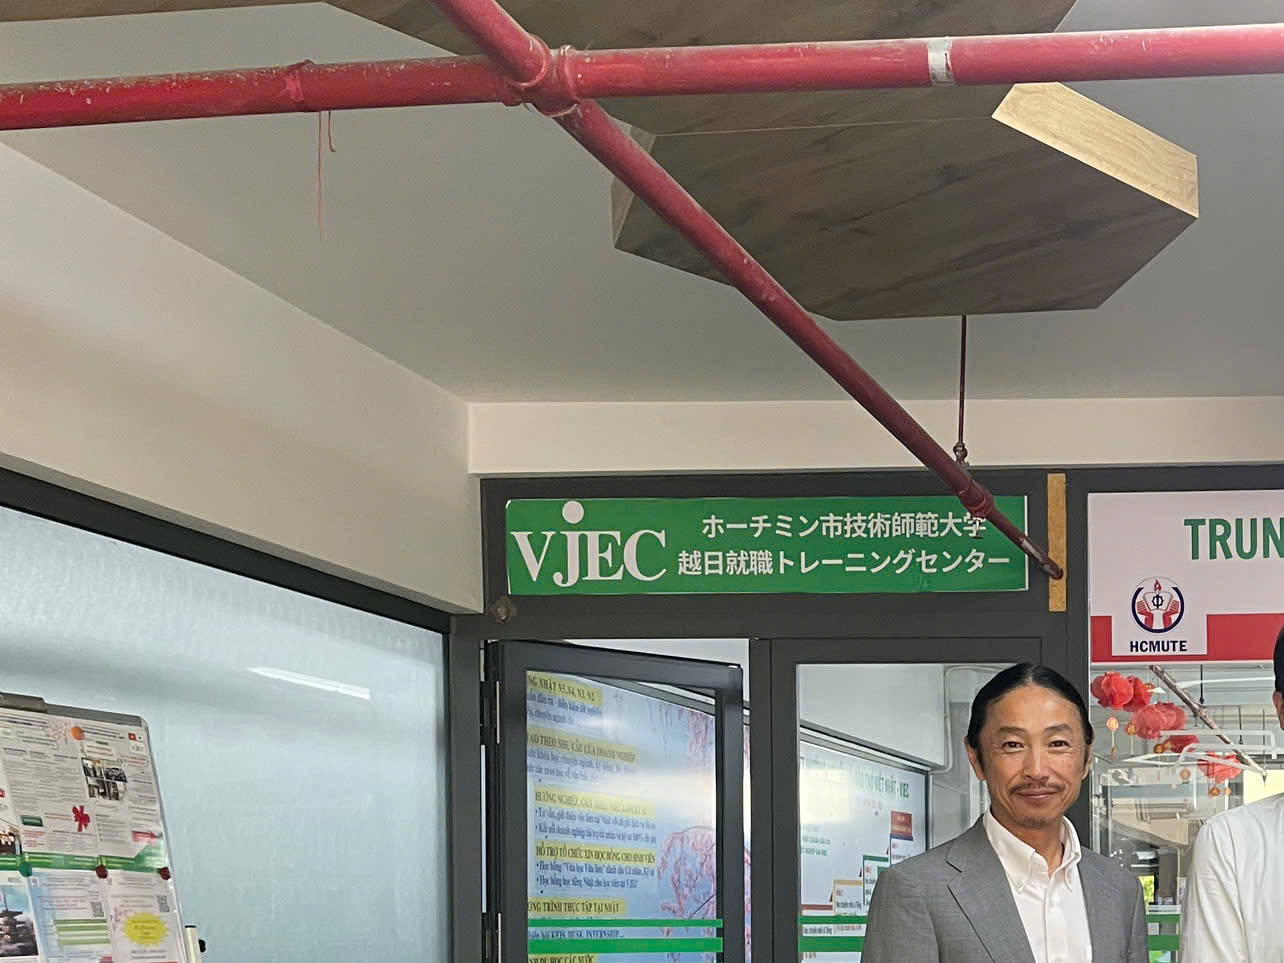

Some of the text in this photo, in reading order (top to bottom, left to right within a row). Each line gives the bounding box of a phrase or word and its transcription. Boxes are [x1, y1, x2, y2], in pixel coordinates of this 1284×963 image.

[701, 511, 986, 538] ホーチミン市技術師範大学
[677, 548, 1010, 577] 越日就職トレーニングセンター
[1129, 639, 1188, 653] HCMUTE
